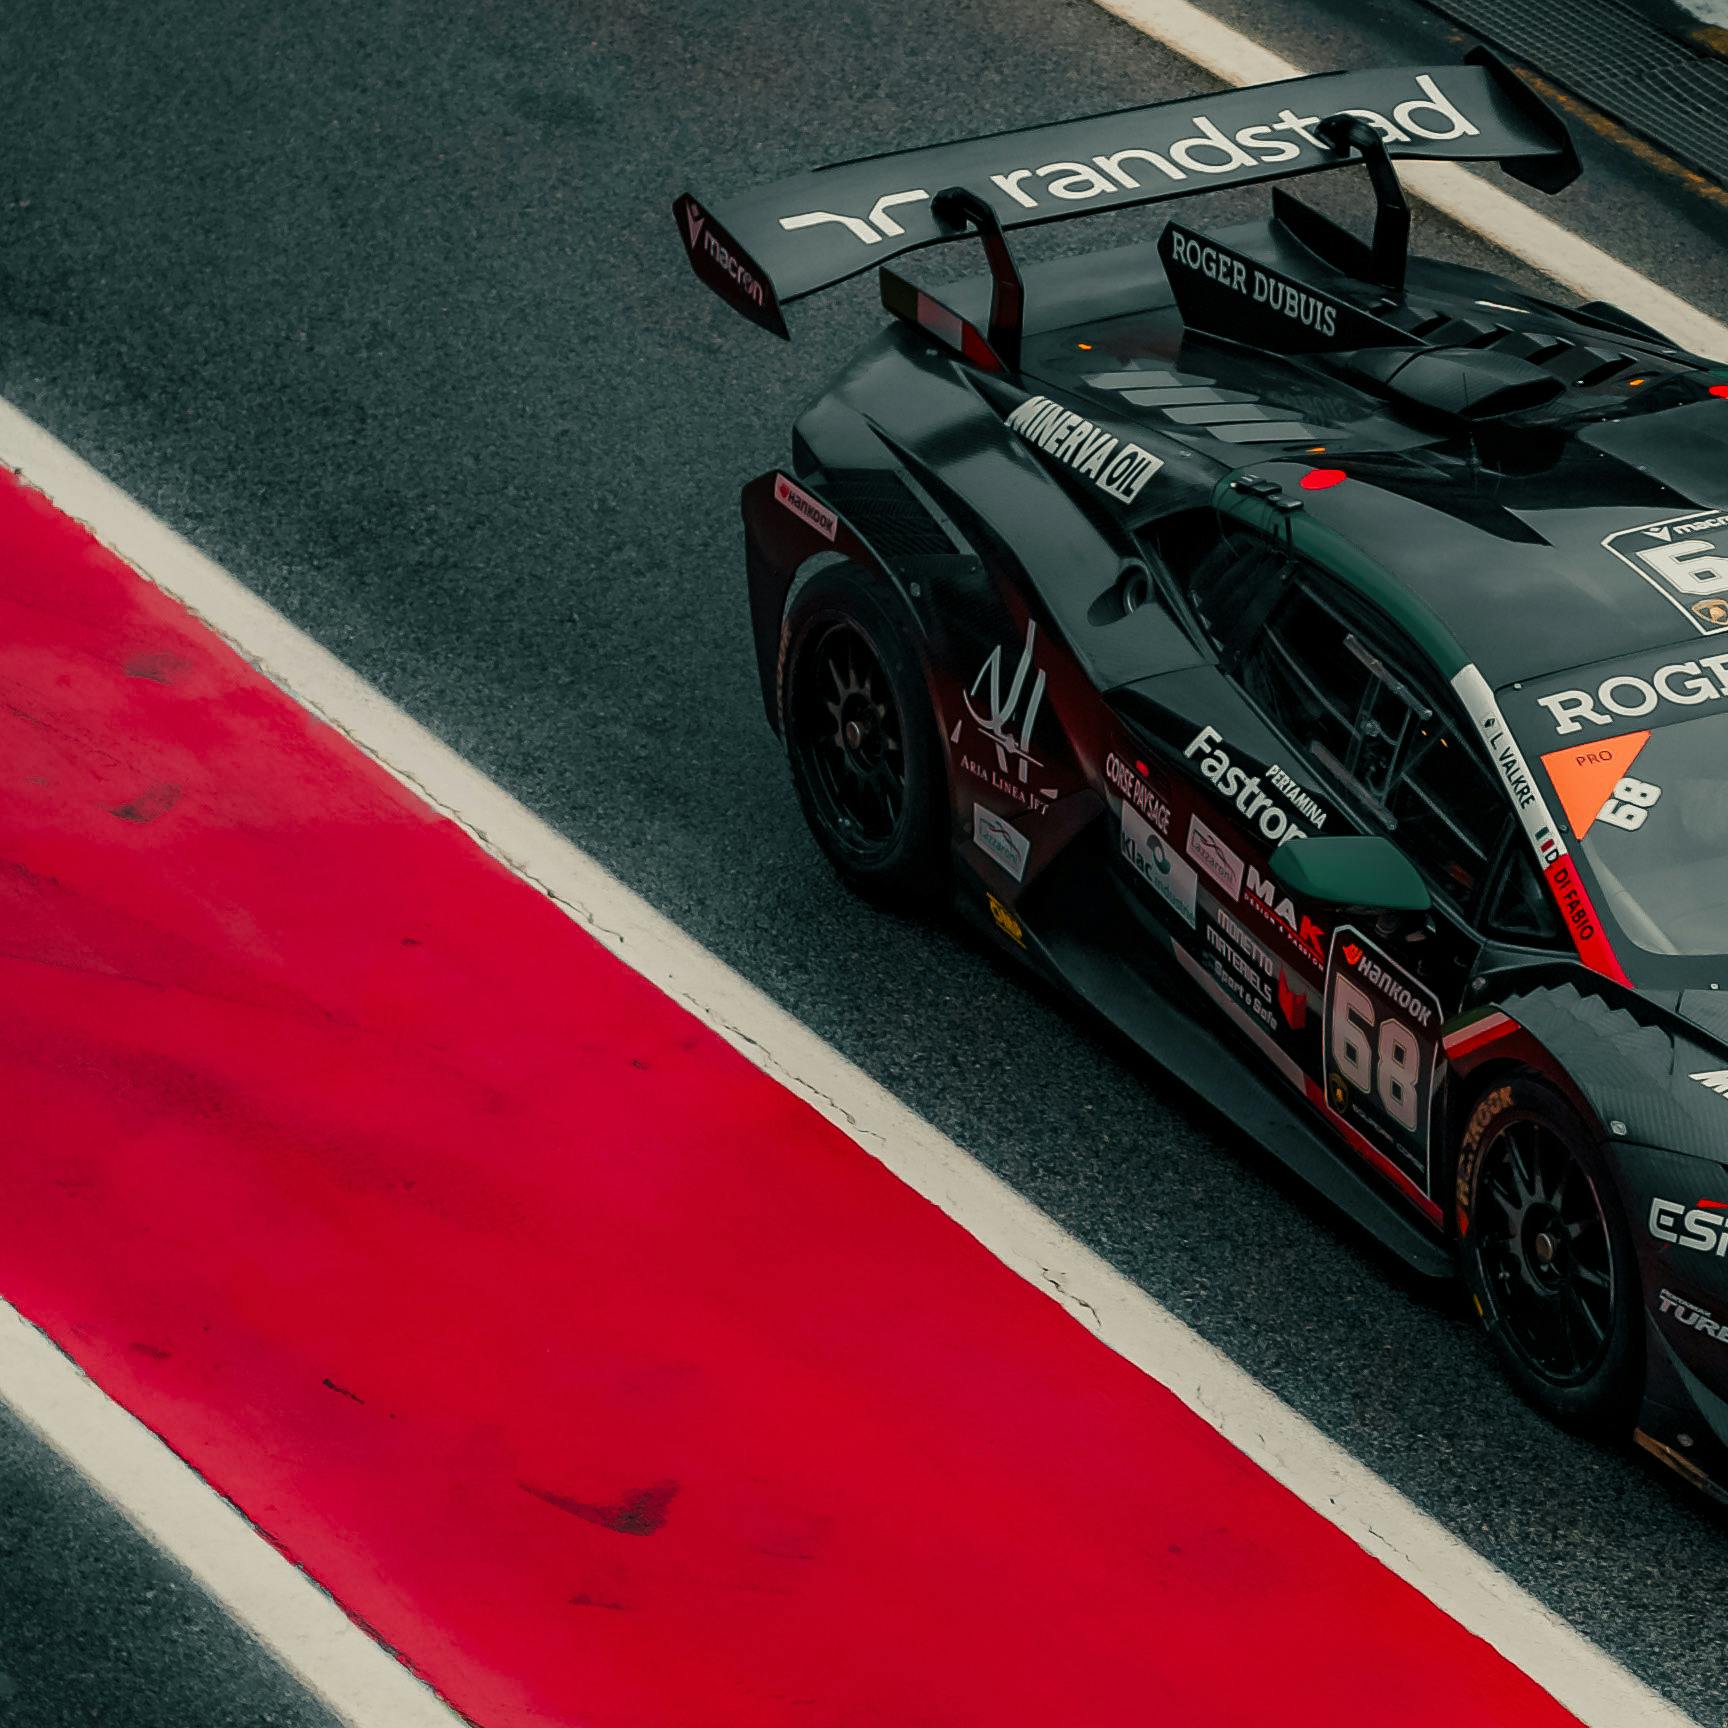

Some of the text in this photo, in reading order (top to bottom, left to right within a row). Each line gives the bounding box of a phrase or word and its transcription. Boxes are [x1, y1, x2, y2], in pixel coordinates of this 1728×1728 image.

[990, 74, 1480, 209] randstad
[704, 228, 765, 307] macron
[1171, 229, 1338, 338] ROGER DUBUIS
[1004, 395, 1151, 498] MINERVA OIL
[959, 753, 989, 783] ARIA
[1105, 752, 1172, 836] CORSE PAYSAGE
[1265, 764, 1327, 830] PERTAMINA
[1498, 746, 1536, 810] VALKRE
[1575, 749, 1613, 767] PRO
[1595, 776, 1662, 832] 68
[1246, 864, 1327, 958] MAK
[1562, 889, 1595, 941] FABIO
[1332, 972, 1421, 1133] 68
